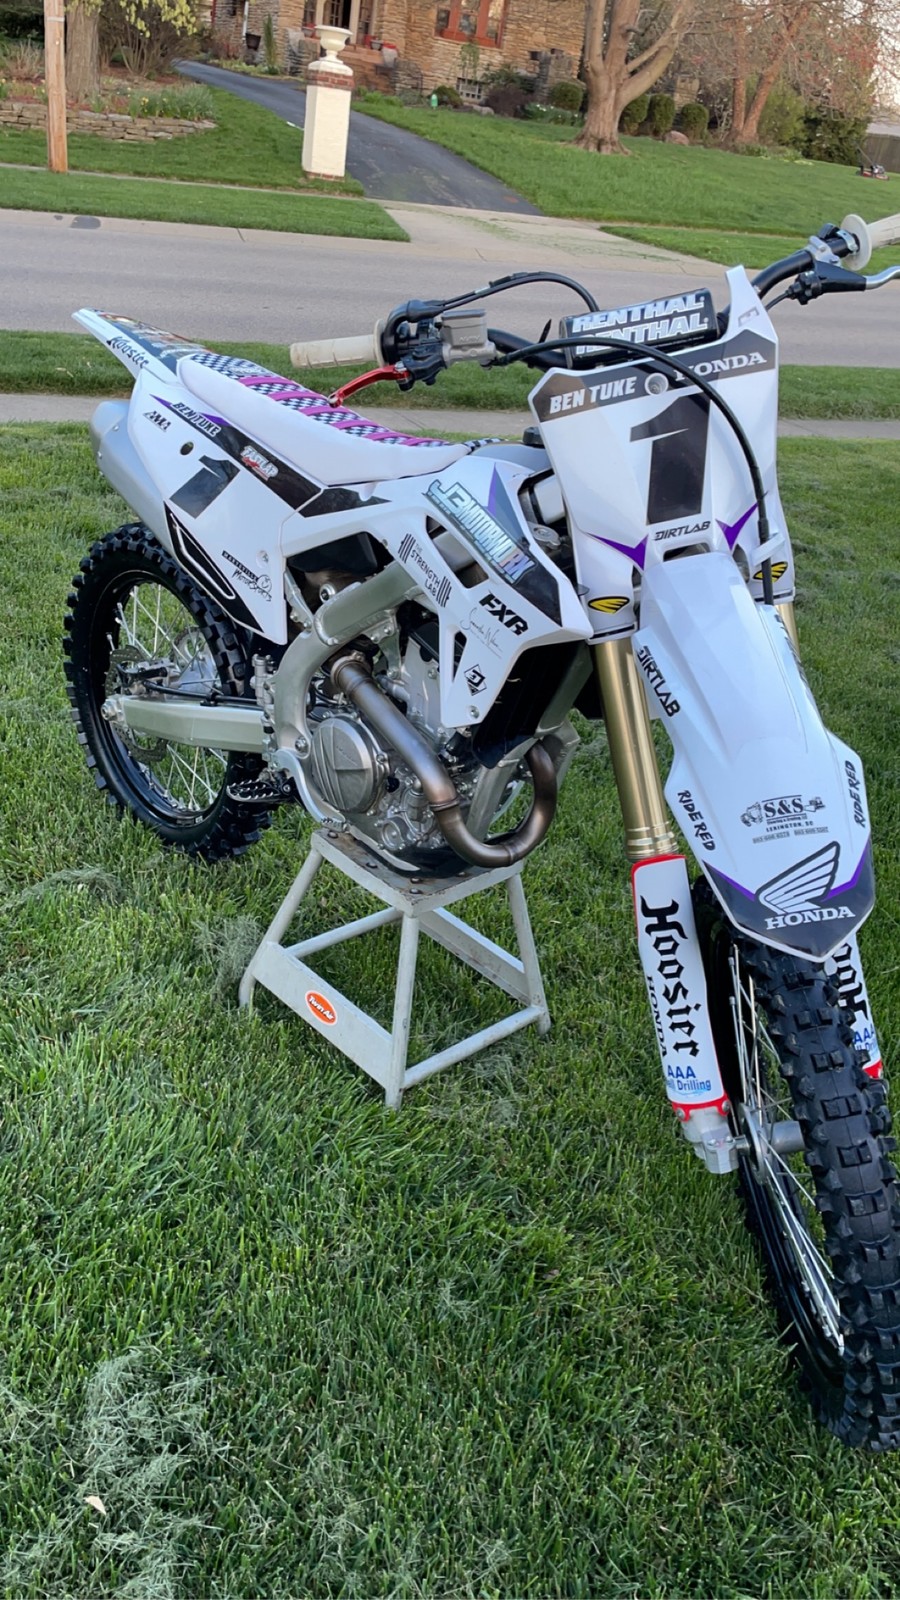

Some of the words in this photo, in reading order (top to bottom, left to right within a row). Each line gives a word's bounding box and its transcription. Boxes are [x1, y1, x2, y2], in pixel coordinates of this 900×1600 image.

[572, 293, 705, 334] RENTHAL
[106, 336, 150, 369] Hoosier
[576, 312, 708, 355] RENTHAL
[549, 388, 586, 414] BEN
[588, 376, 638, 404] TUKE
[172, 402, 197, 421] BEN
[195, 413, 221, 437] TUKE
[629, 392, 712, 526] 1
[169, 454, 241, 520] 1
[653, 520, 711, 542] DIRTLAB
[410, 549, 441, 588] STRENGTH
[424, 578, 437, 597] LAB
[479, 593, 529, 636] FXR
[636, 645, 682, 718] DIRTLAB
[845, 760, 861, 792] RED
[677, 790, 704, 822] RIDE
[694, 821, 717, 851] RED
[762, 797, 805, 818] S&S
[849, 788, 866, 829] RIDE
[765, 906, 857, 931] HONDA
[640, 895, 702, 1058] Hoosier
[646, 976, 668, 1058] HONDA
[667, 1064, 697, 1079] AAA
[676, 1079, 712, 1095] Drilling
